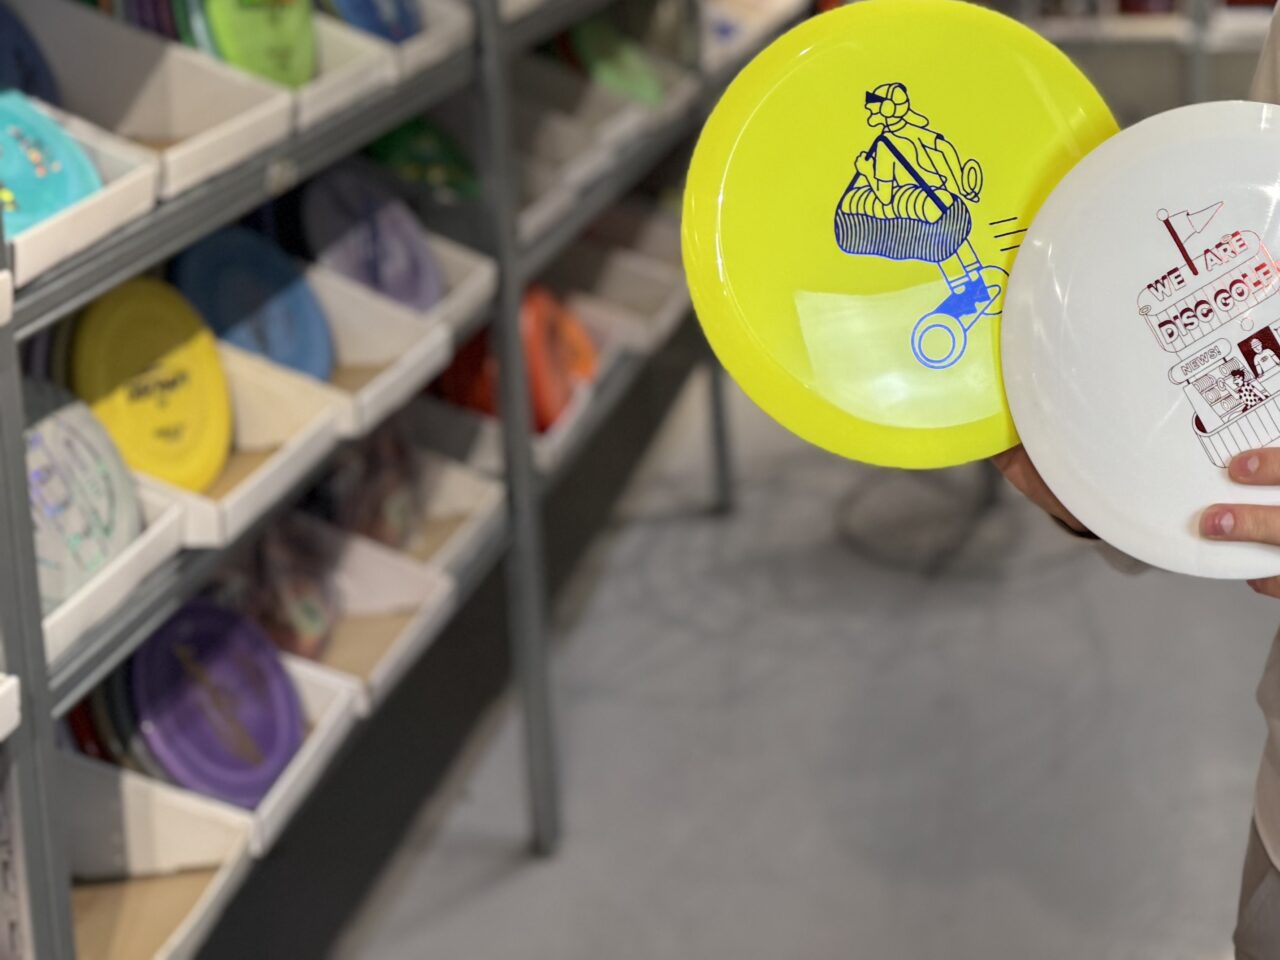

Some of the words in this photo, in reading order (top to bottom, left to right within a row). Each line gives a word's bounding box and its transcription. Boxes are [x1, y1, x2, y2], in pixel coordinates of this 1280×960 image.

[1147, 267, 1185, 301] WE
[1204, 230, 1248, 271] ARE
[1158, 300, 1213, 344] DISC
[1180, 346, 1222, 376] NEWS!
